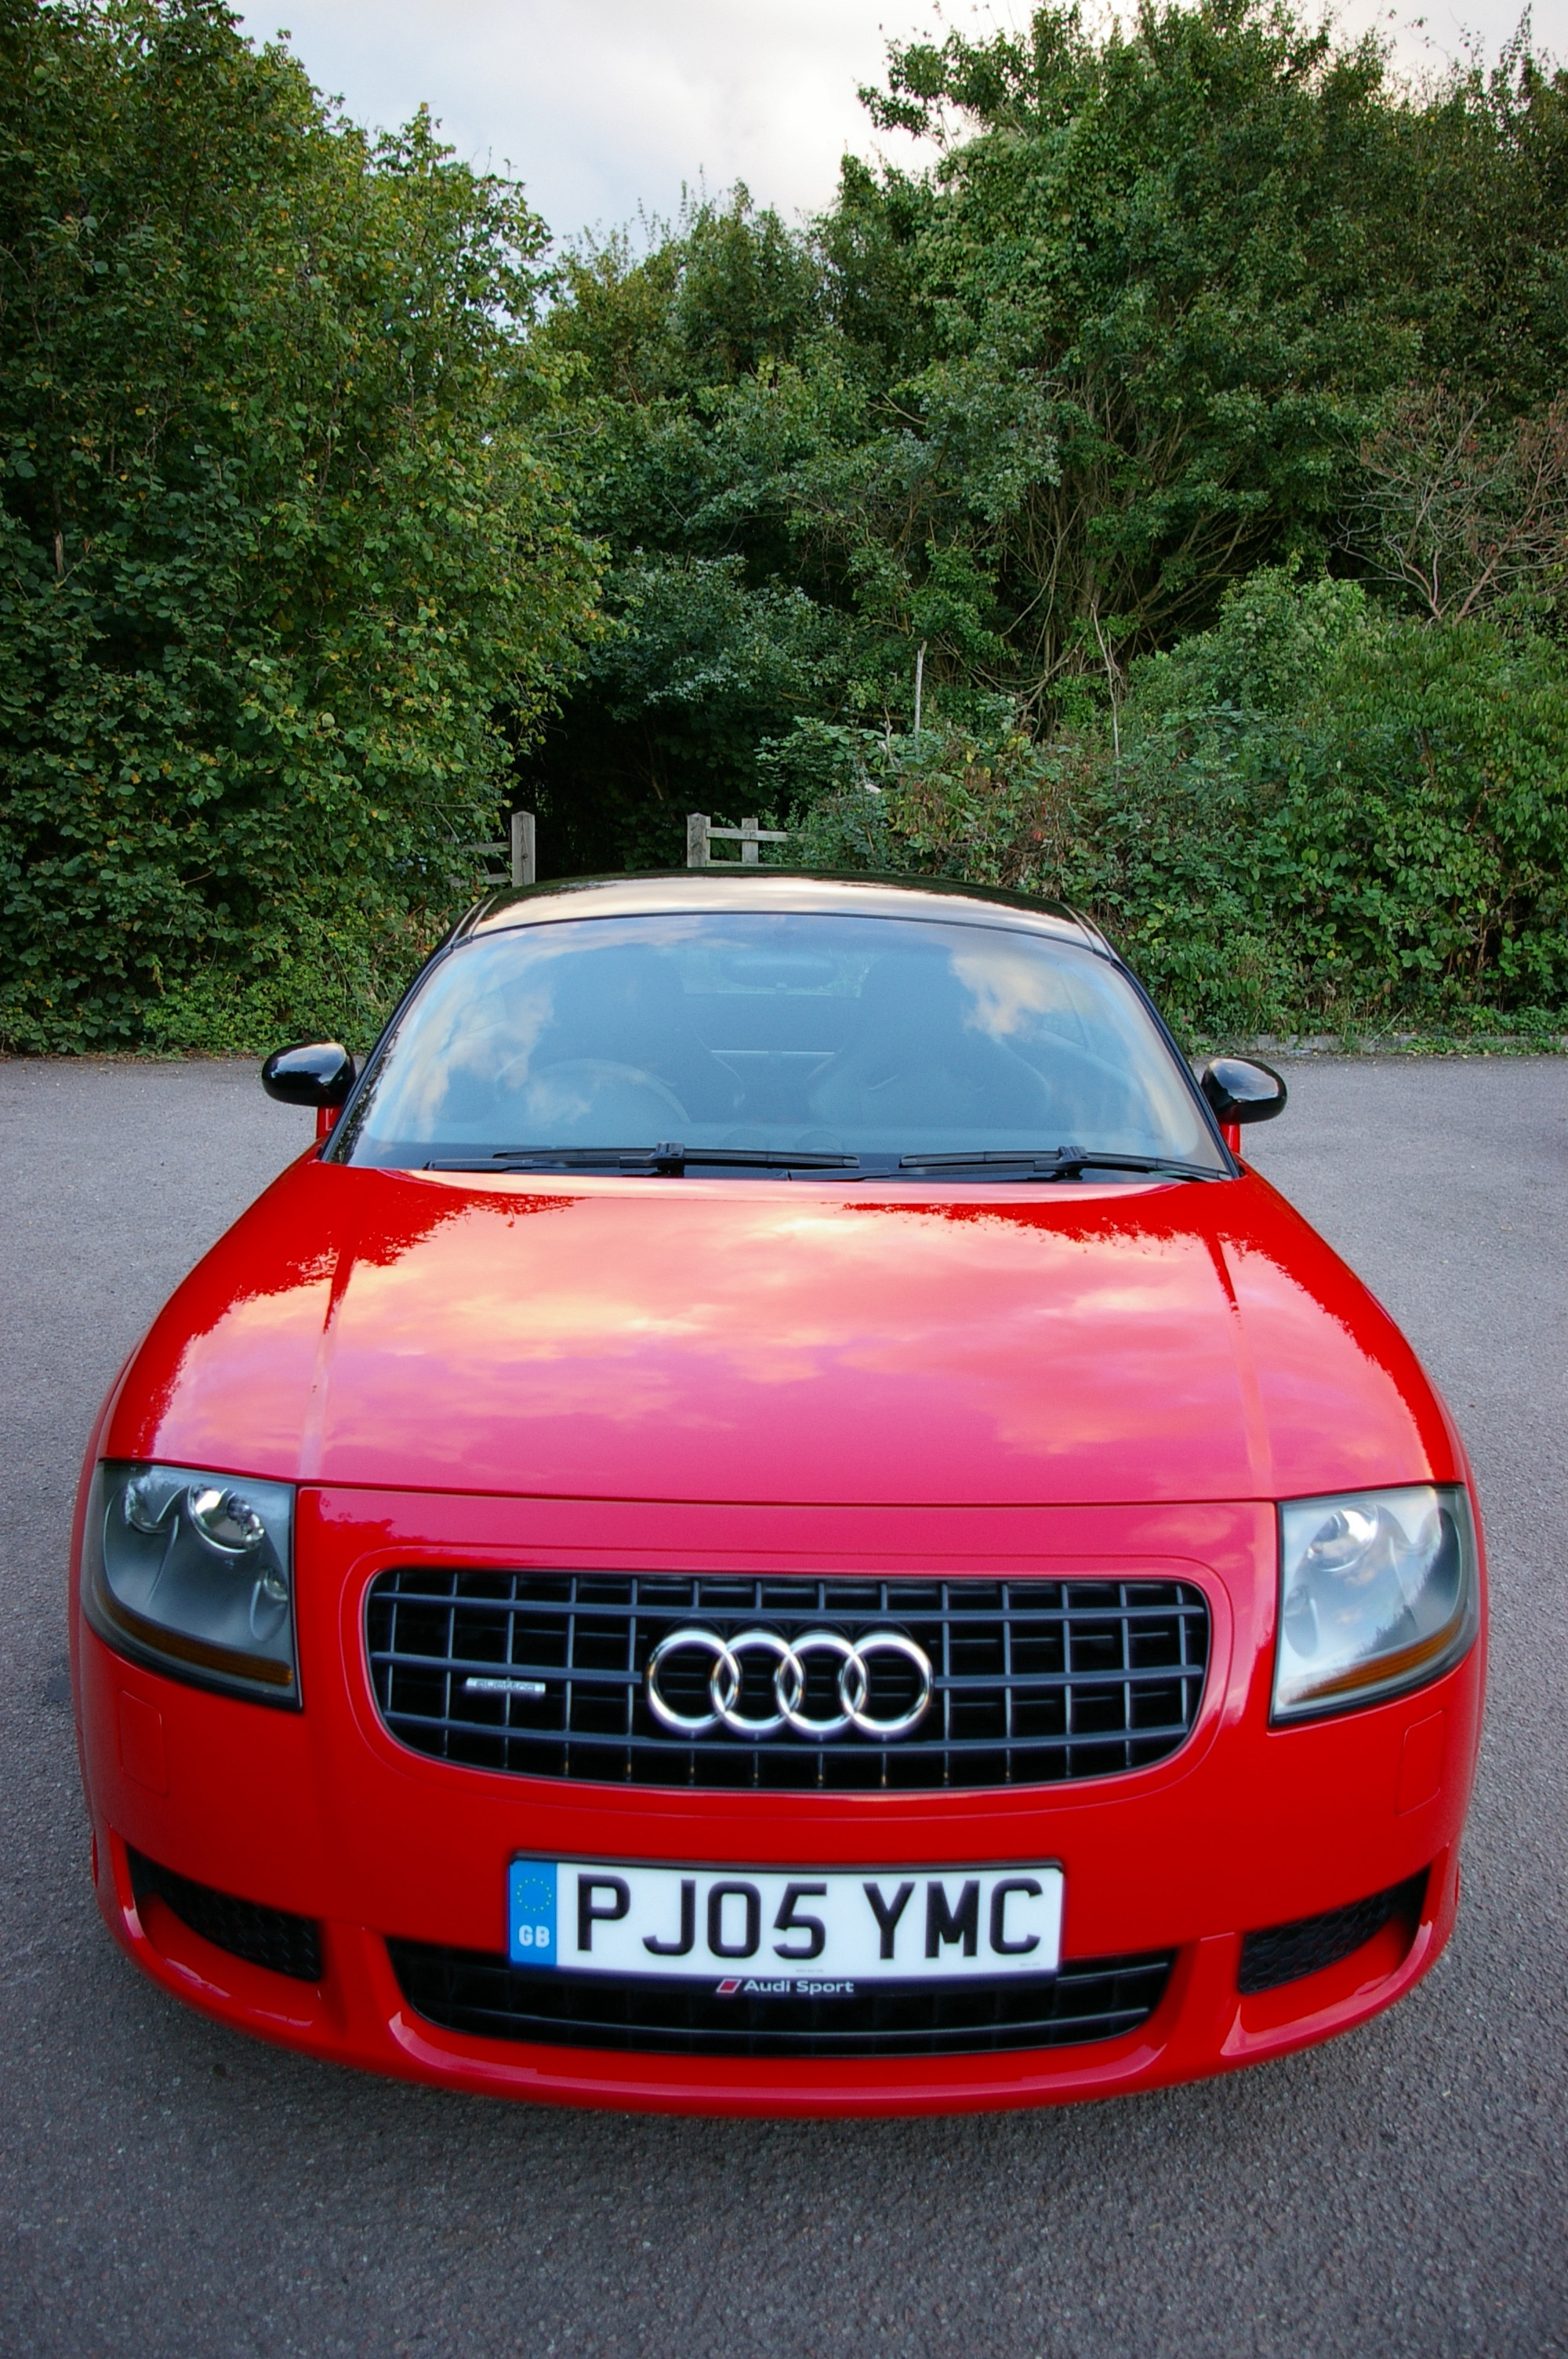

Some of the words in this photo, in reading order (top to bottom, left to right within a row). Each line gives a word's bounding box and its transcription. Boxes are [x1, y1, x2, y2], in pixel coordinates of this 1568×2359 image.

[862, 1878, 1043, 1960] YMC
[518, 1925, 550, 1948] GB
[743, 1979, 791, 1992] Audi
[796, 1980, 855, 1995] Sport
